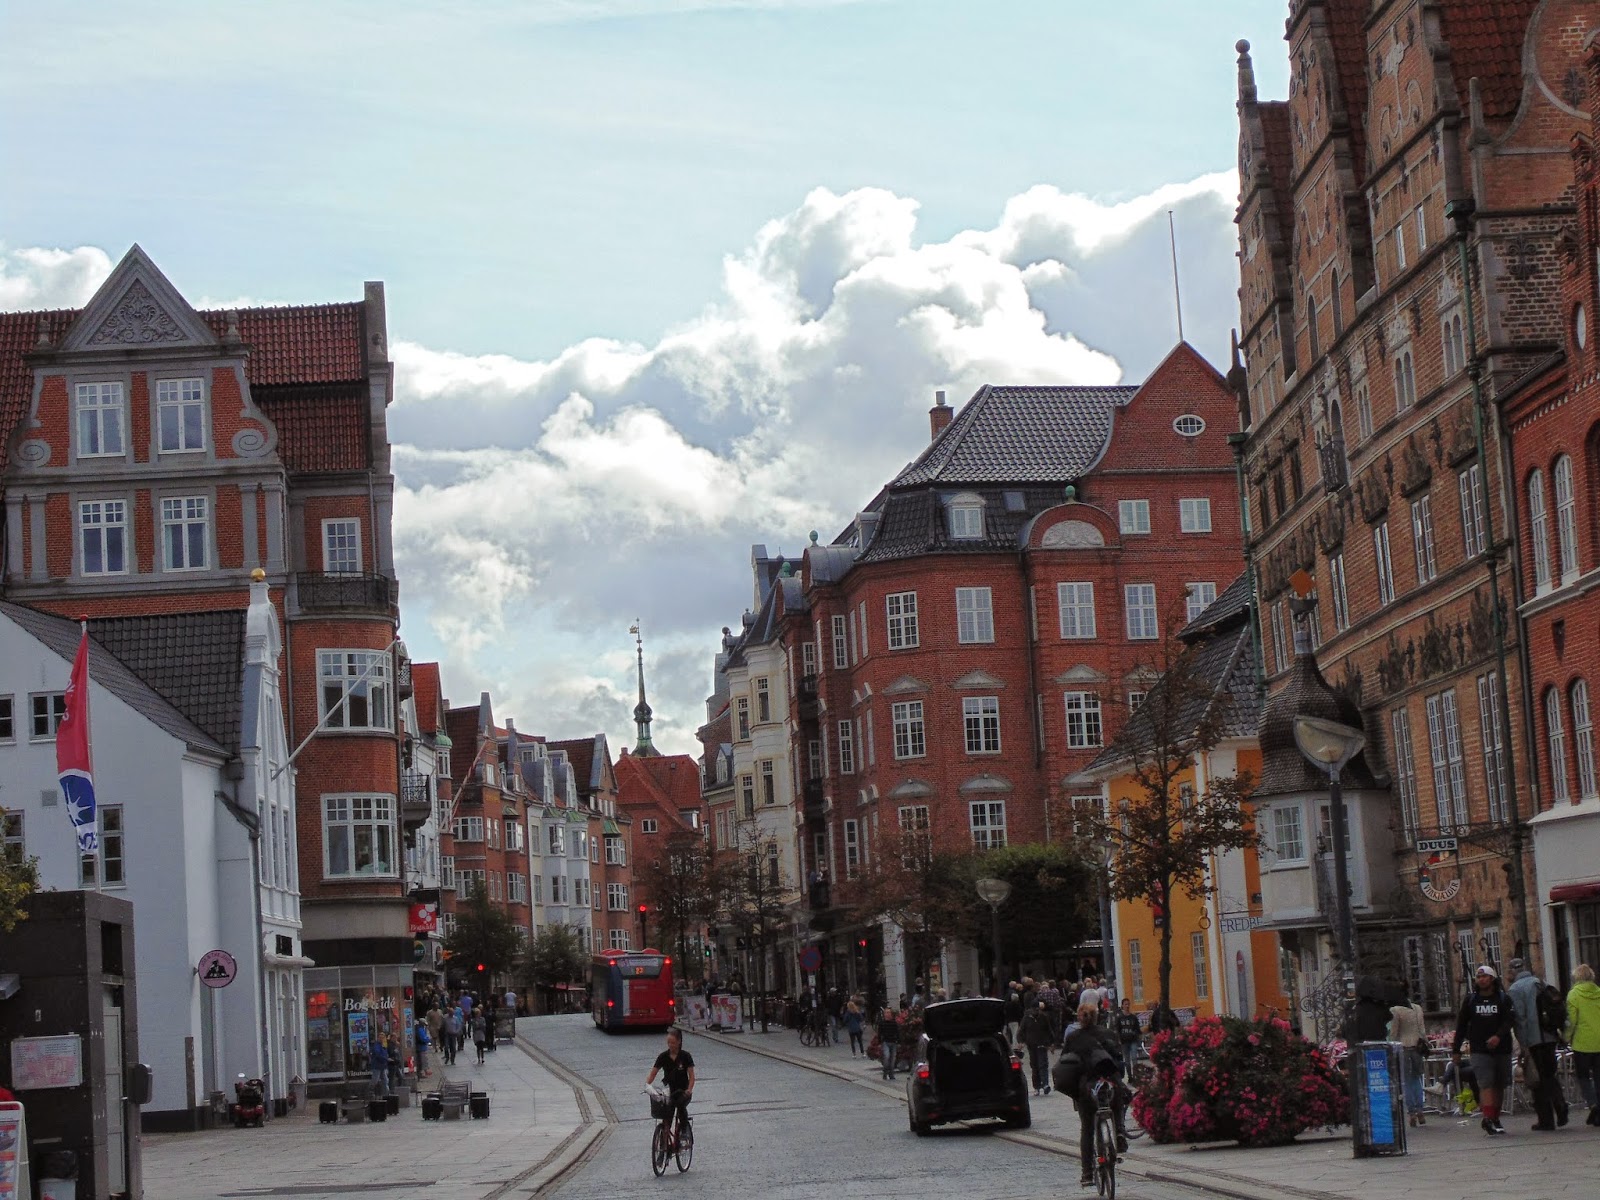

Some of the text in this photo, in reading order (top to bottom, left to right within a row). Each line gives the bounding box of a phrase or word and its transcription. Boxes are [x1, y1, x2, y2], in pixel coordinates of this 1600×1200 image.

[1419, 841, 1454, 850] DUUS
[344, 998, 369, 1012] Bog
[380, 996, 396, 1010] idé
[1476, 1005, 1498, 1014] IMG
